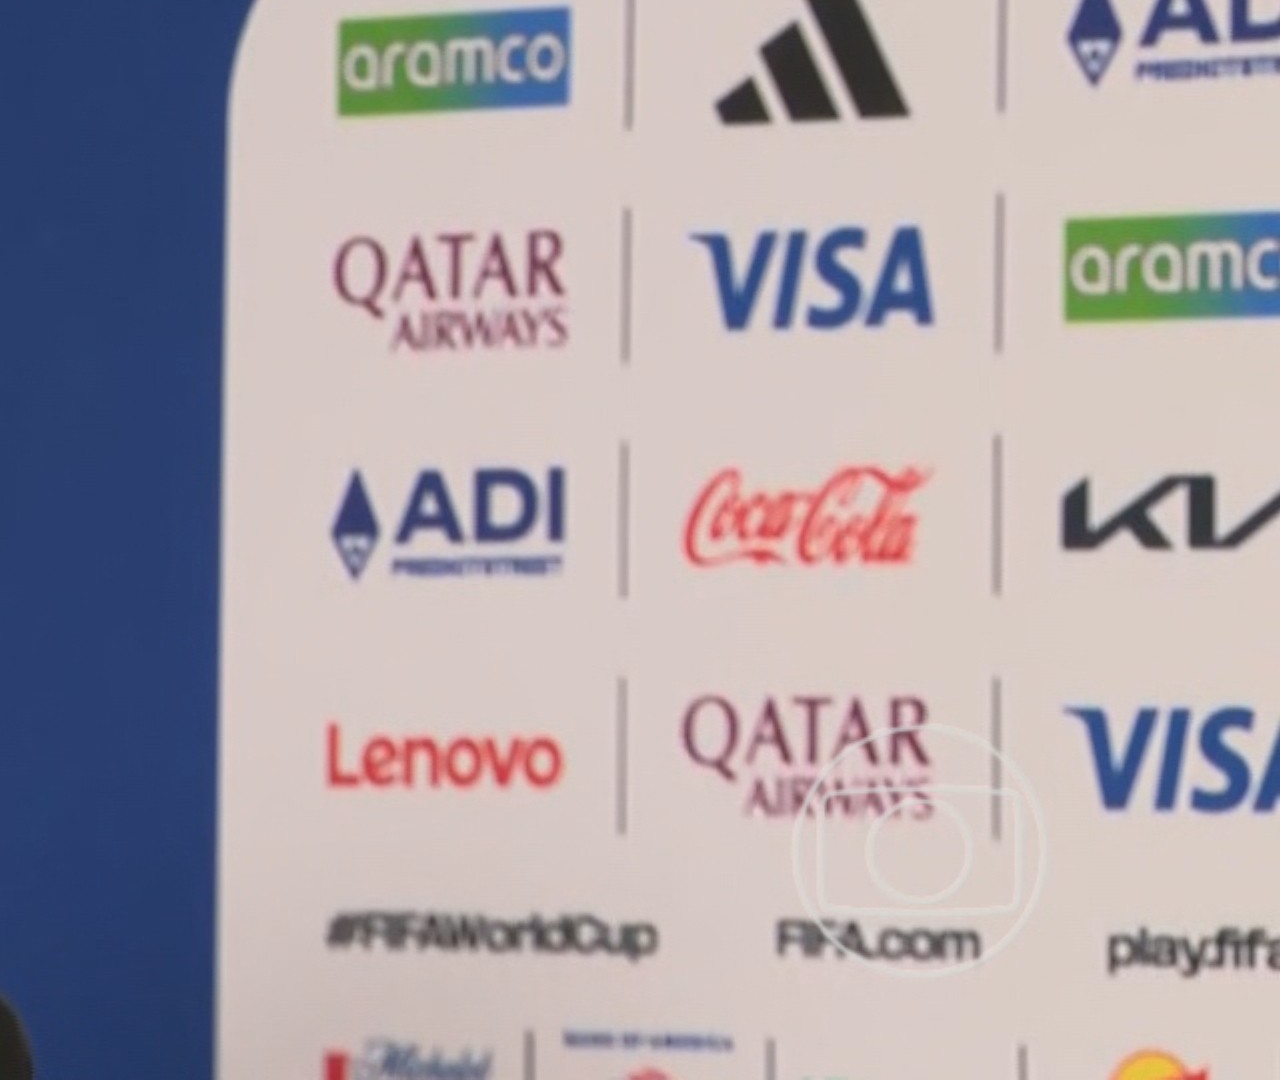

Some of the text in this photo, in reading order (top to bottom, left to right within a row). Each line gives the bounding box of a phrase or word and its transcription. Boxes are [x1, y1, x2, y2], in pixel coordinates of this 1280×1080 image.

[343, 31, 567, 92] aramco
[333, 228, 567, 320] QATAR
[687, 226, 935, 332] VISA
[392, 306, 569, 353] AIRWAYS
[393, 467, 566, 545] ADI
[326, 721, 563, 789] Lenovo
[681, 694, 931, 782] QATAR
[746, 777, 936, 820] AIRWAYS
[326, 911, 659, 962] #FIFAWorldCup
[776, 919, 982, 961] FIFA.com
